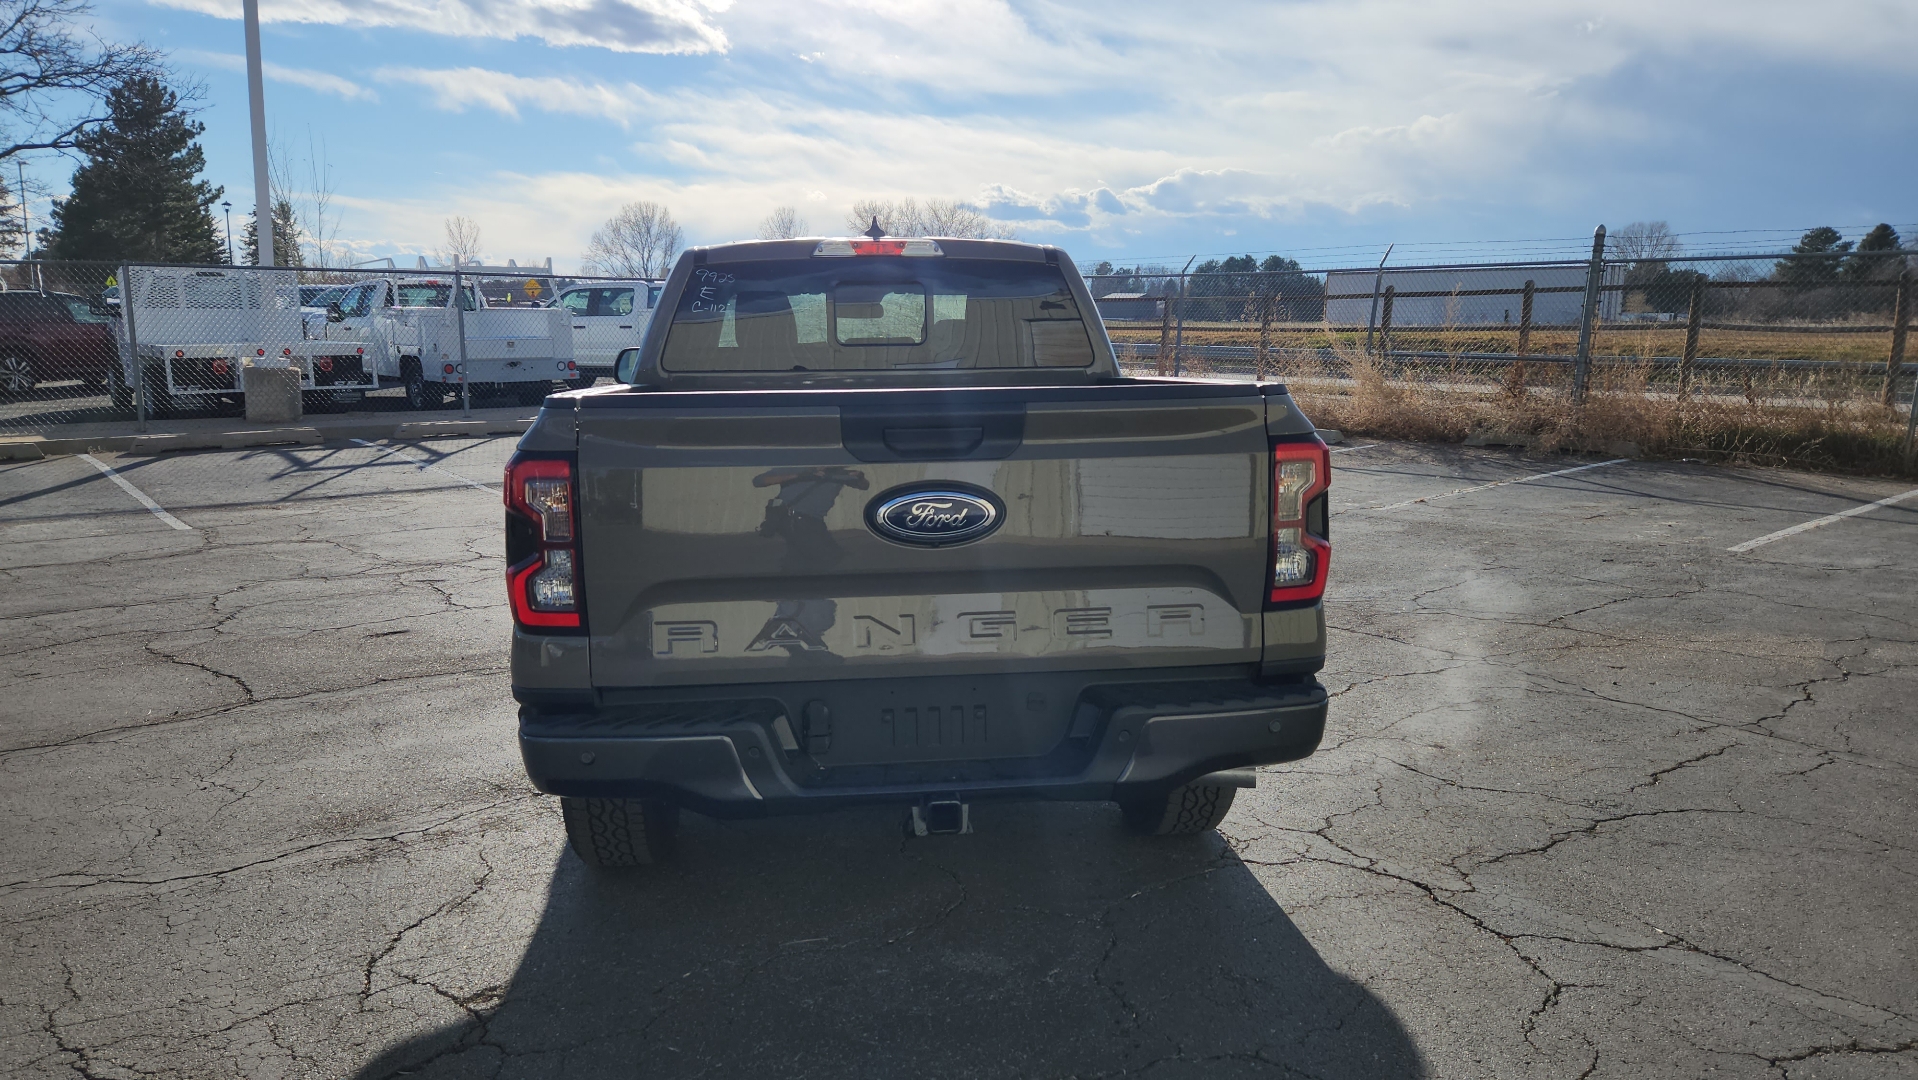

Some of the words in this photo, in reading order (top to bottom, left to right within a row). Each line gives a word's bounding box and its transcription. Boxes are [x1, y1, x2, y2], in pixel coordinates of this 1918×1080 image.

[699, 285, 717, 301] E
[691, 300, 726, 313] C-112
[905, 502, 969, 529] Ford
[652, 603, 1206, 655] RANGER
